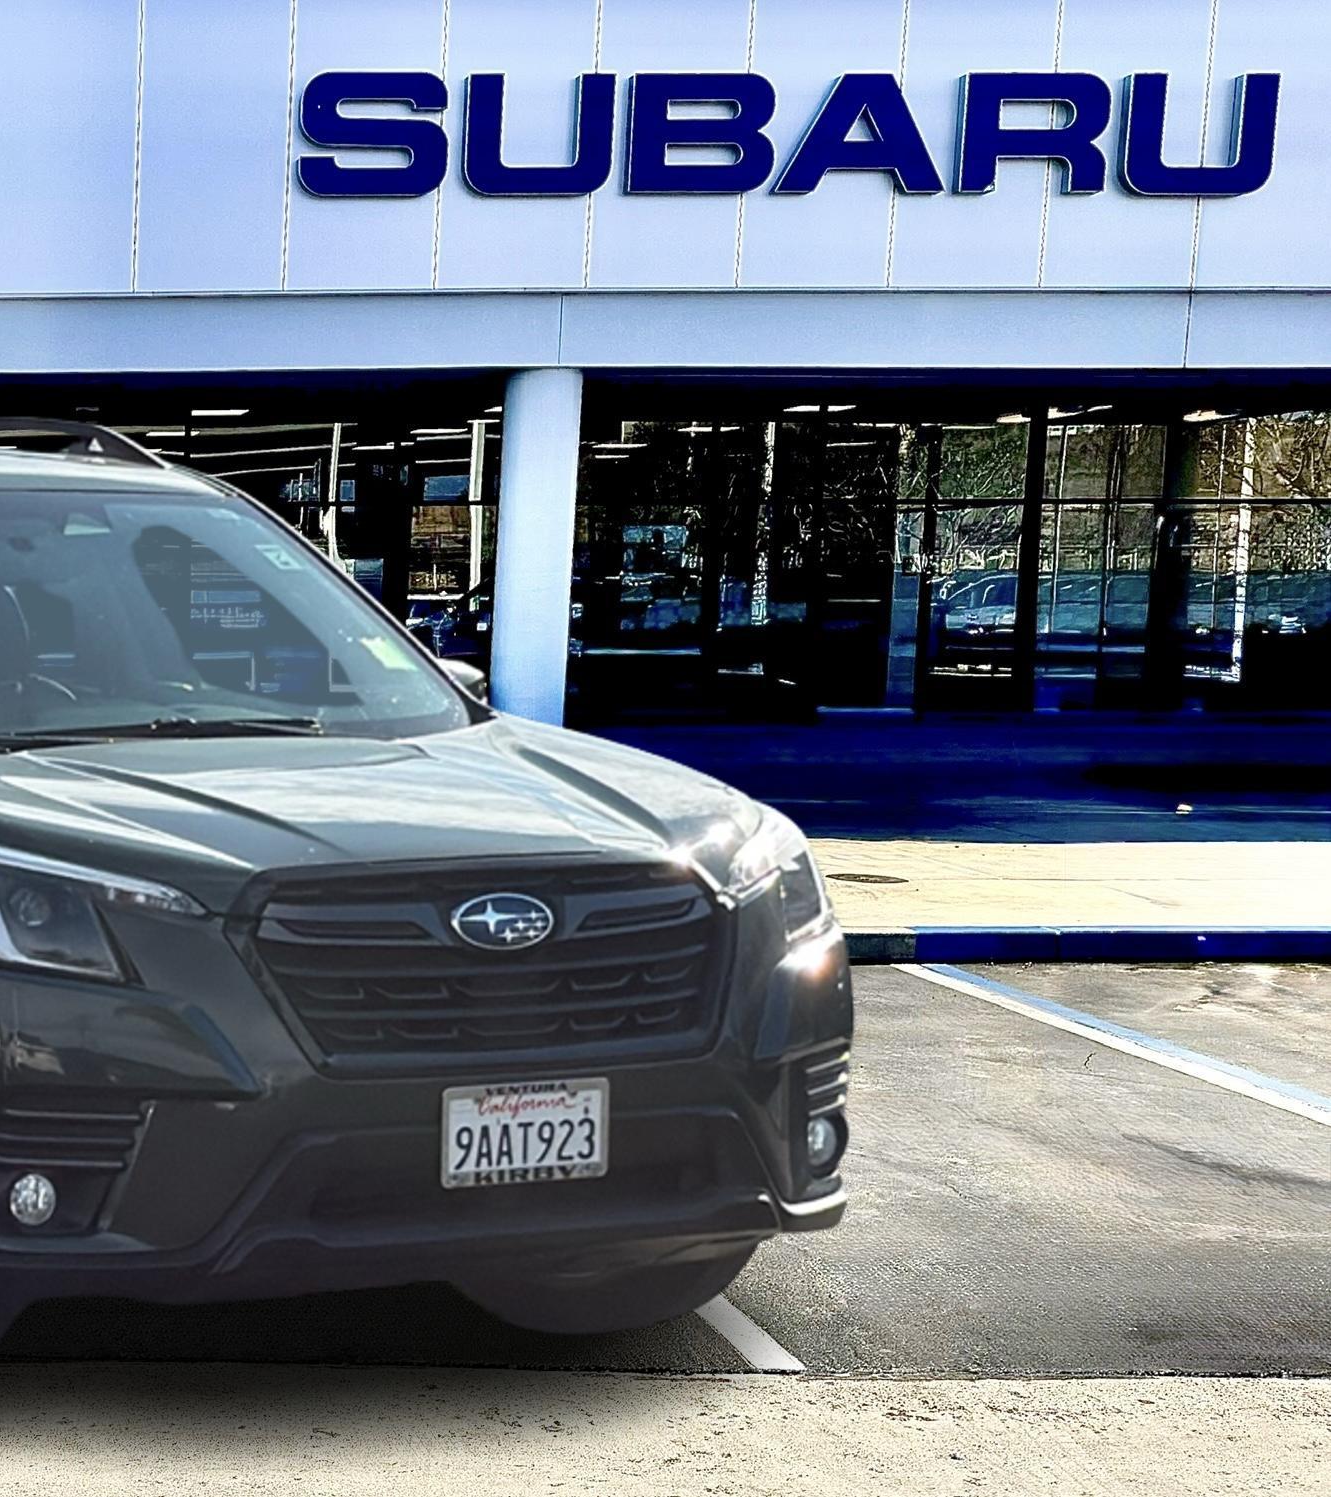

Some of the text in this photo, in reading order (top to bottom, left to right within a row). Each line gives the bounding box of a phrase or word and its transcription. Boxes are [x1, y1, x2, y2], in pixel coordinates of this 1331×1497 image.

[297, 70, 1280, 198] SUBARU
[485, 1082, 569, 1096] VENTURA
[478, 1095, 575, 1119] California
[454, 1117, 596, 1170] 9AAT923
[474, 1165, 577, 1186] KIRBY
